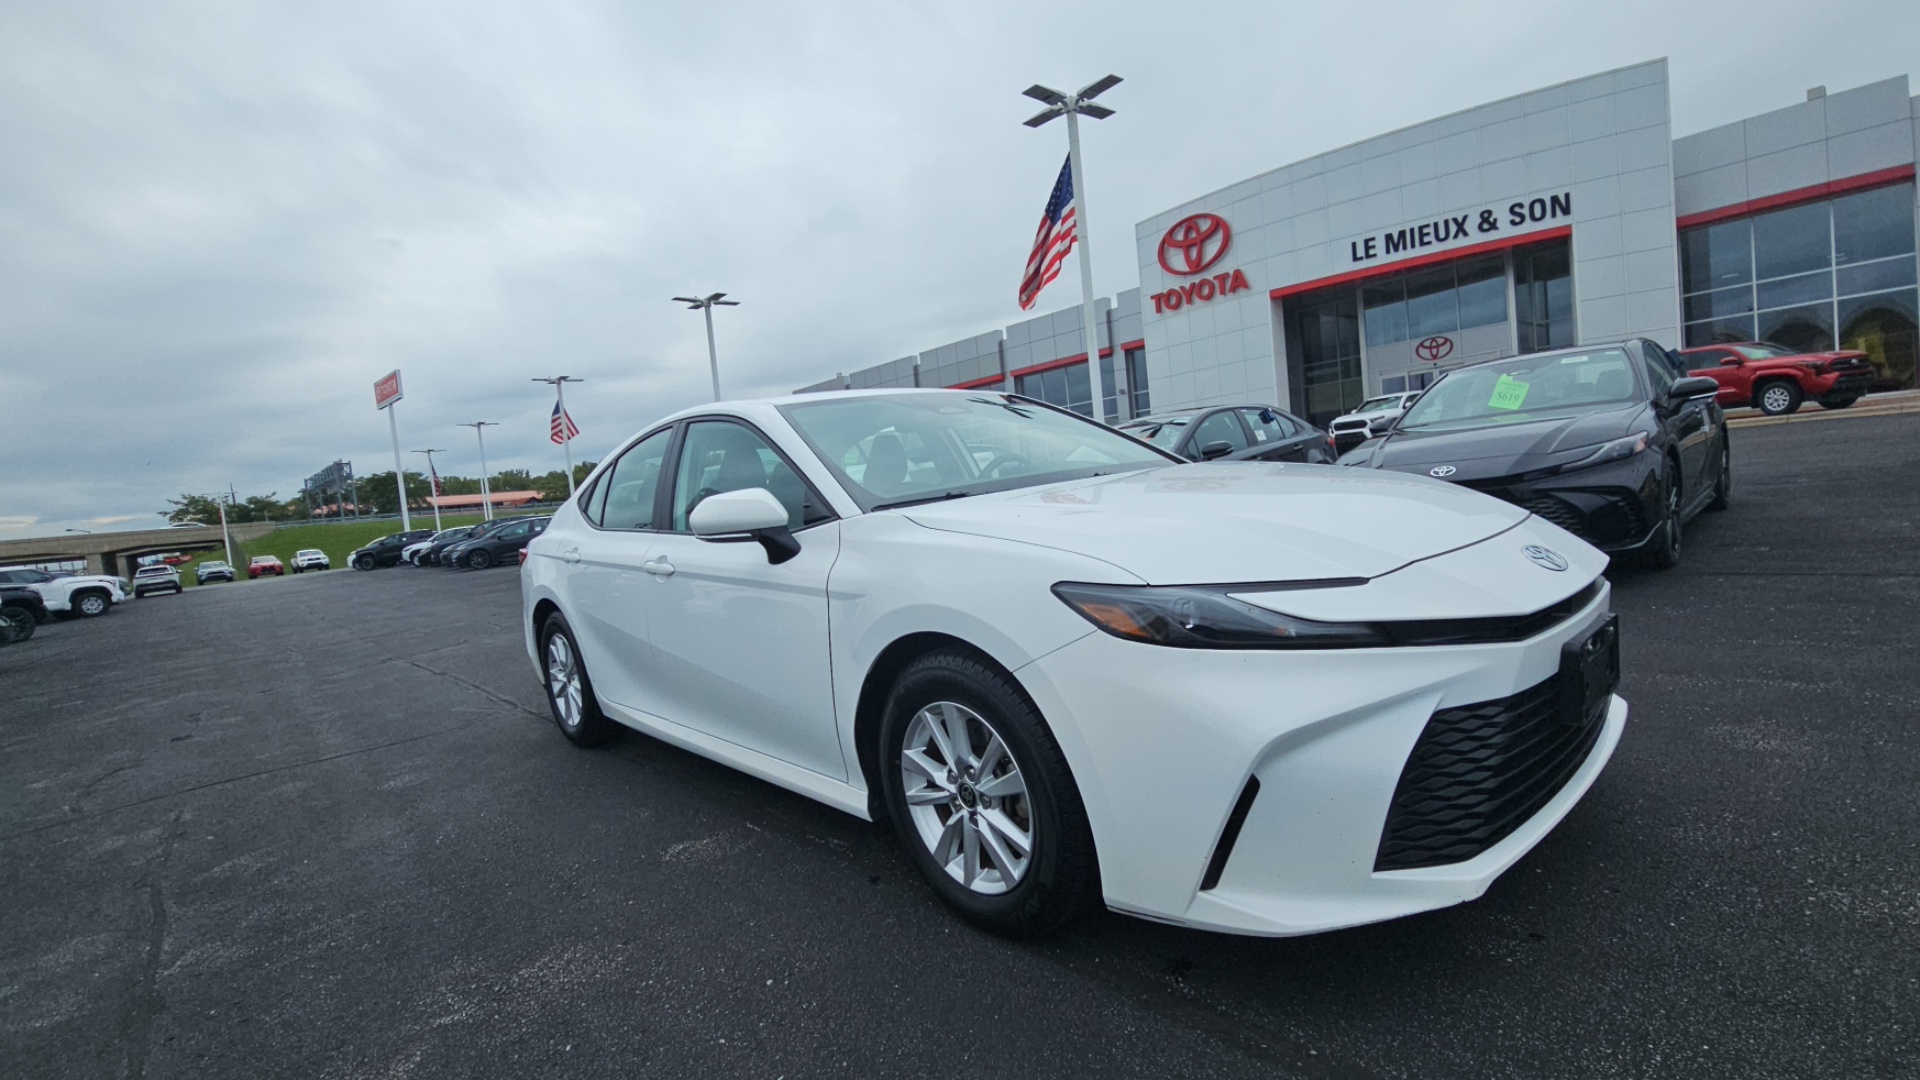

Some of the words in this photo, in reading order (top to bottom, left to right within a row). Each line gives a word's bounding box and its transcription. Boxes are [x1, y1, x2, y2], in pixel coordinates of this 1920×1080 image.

[1351, 237, 1377, 262] LE
[1384, 214, 1469, 254] MIEUX
[1477, 209, 1499, 233] &
[1509, 192, 1571, 226] SON
[1150, 269, 1250, 314] TOYOTA
